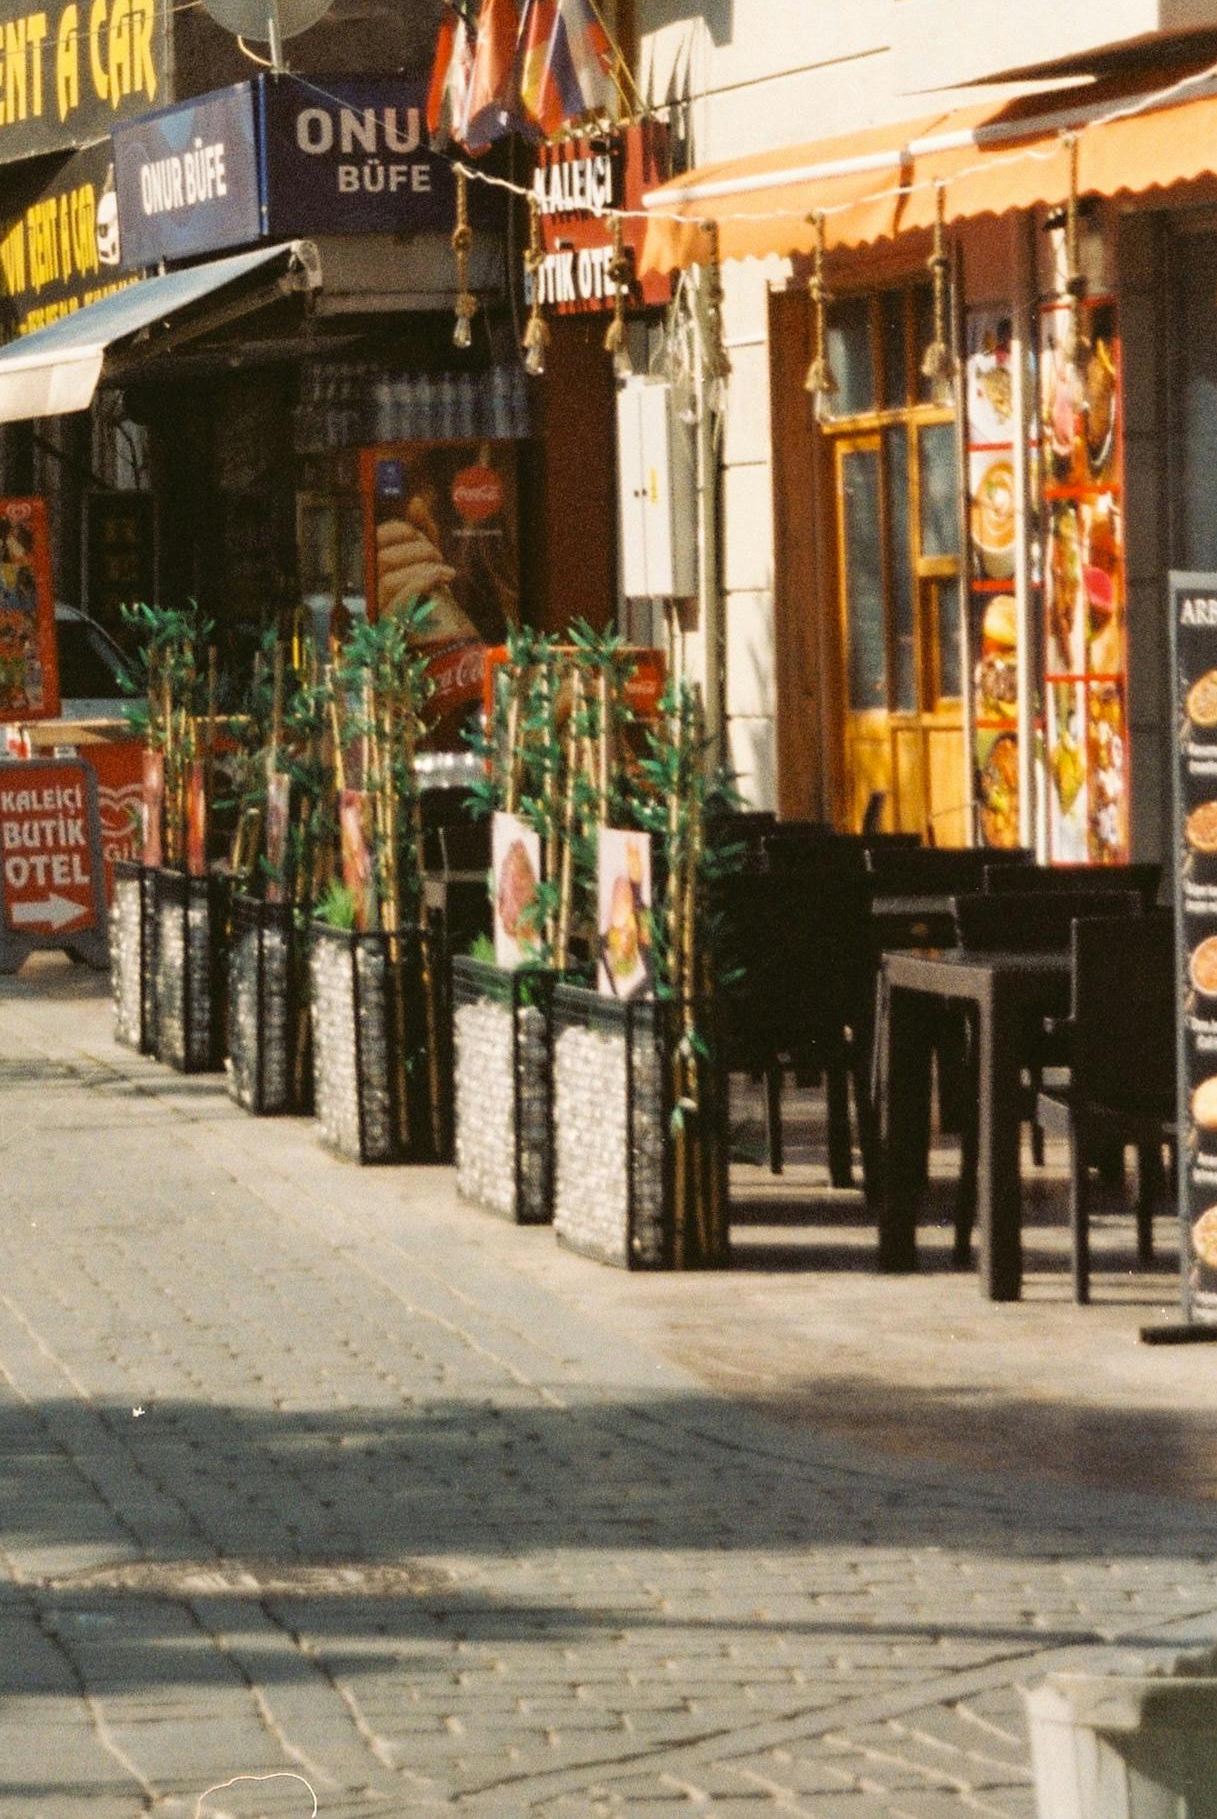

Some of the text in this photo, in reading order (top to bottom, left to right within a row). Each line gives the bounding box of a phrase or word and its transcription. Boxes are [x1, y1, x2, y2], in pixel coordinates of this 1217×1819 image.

[56, 3, 80, 124] A
[296, 107, 421, 155] ONU
[140, 139, 228, 217] ONUR BÜFE
[338, 158, 432, 193] BÜFE
[0, 784, 83, 816] KALEİÇİ
[2, 812, 87, 849] BUTİK
[4, 853, 91, 888] OTEL
